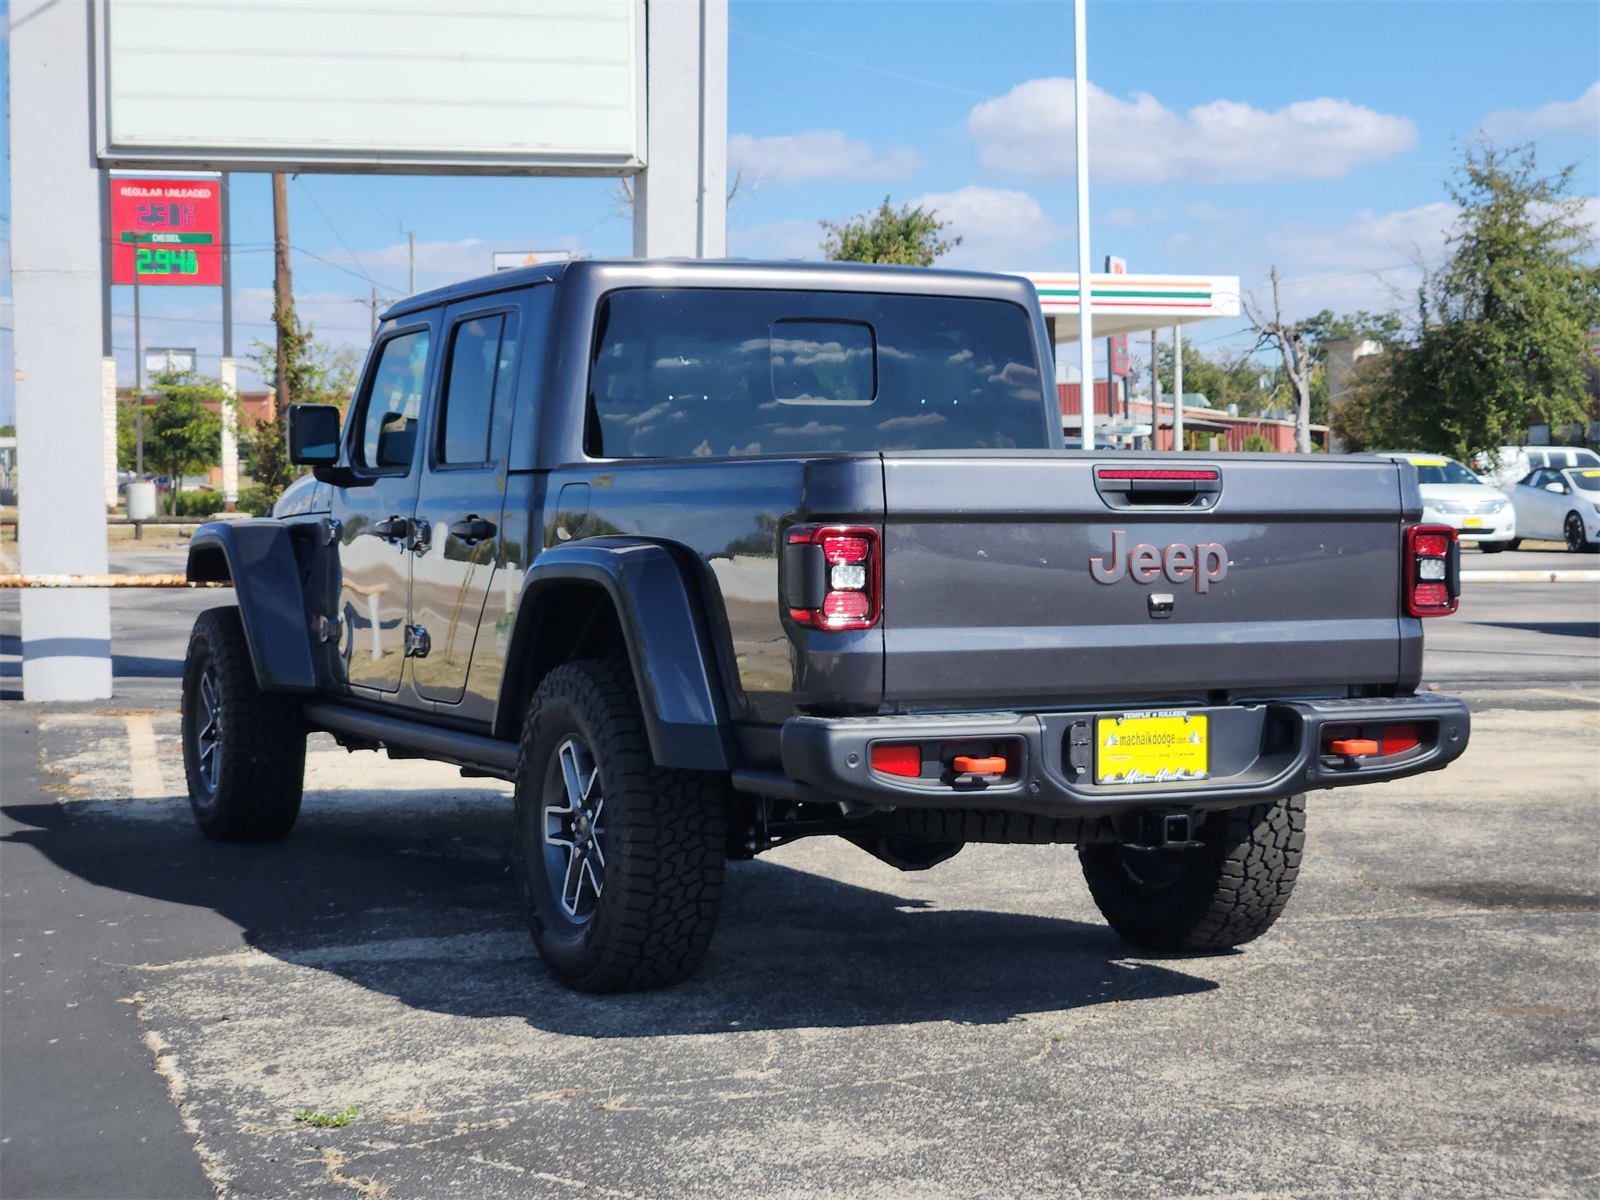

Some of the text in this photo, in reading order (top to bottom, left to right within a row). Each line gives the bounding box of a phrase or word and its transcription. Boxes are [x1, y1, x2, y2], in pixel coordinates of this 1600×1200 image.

[121, 187, 211, 198] REGULAR UNLEADED
[152, 233, 181, 243] DIESEL
[1089, 530, 1228, 595] Jeep
